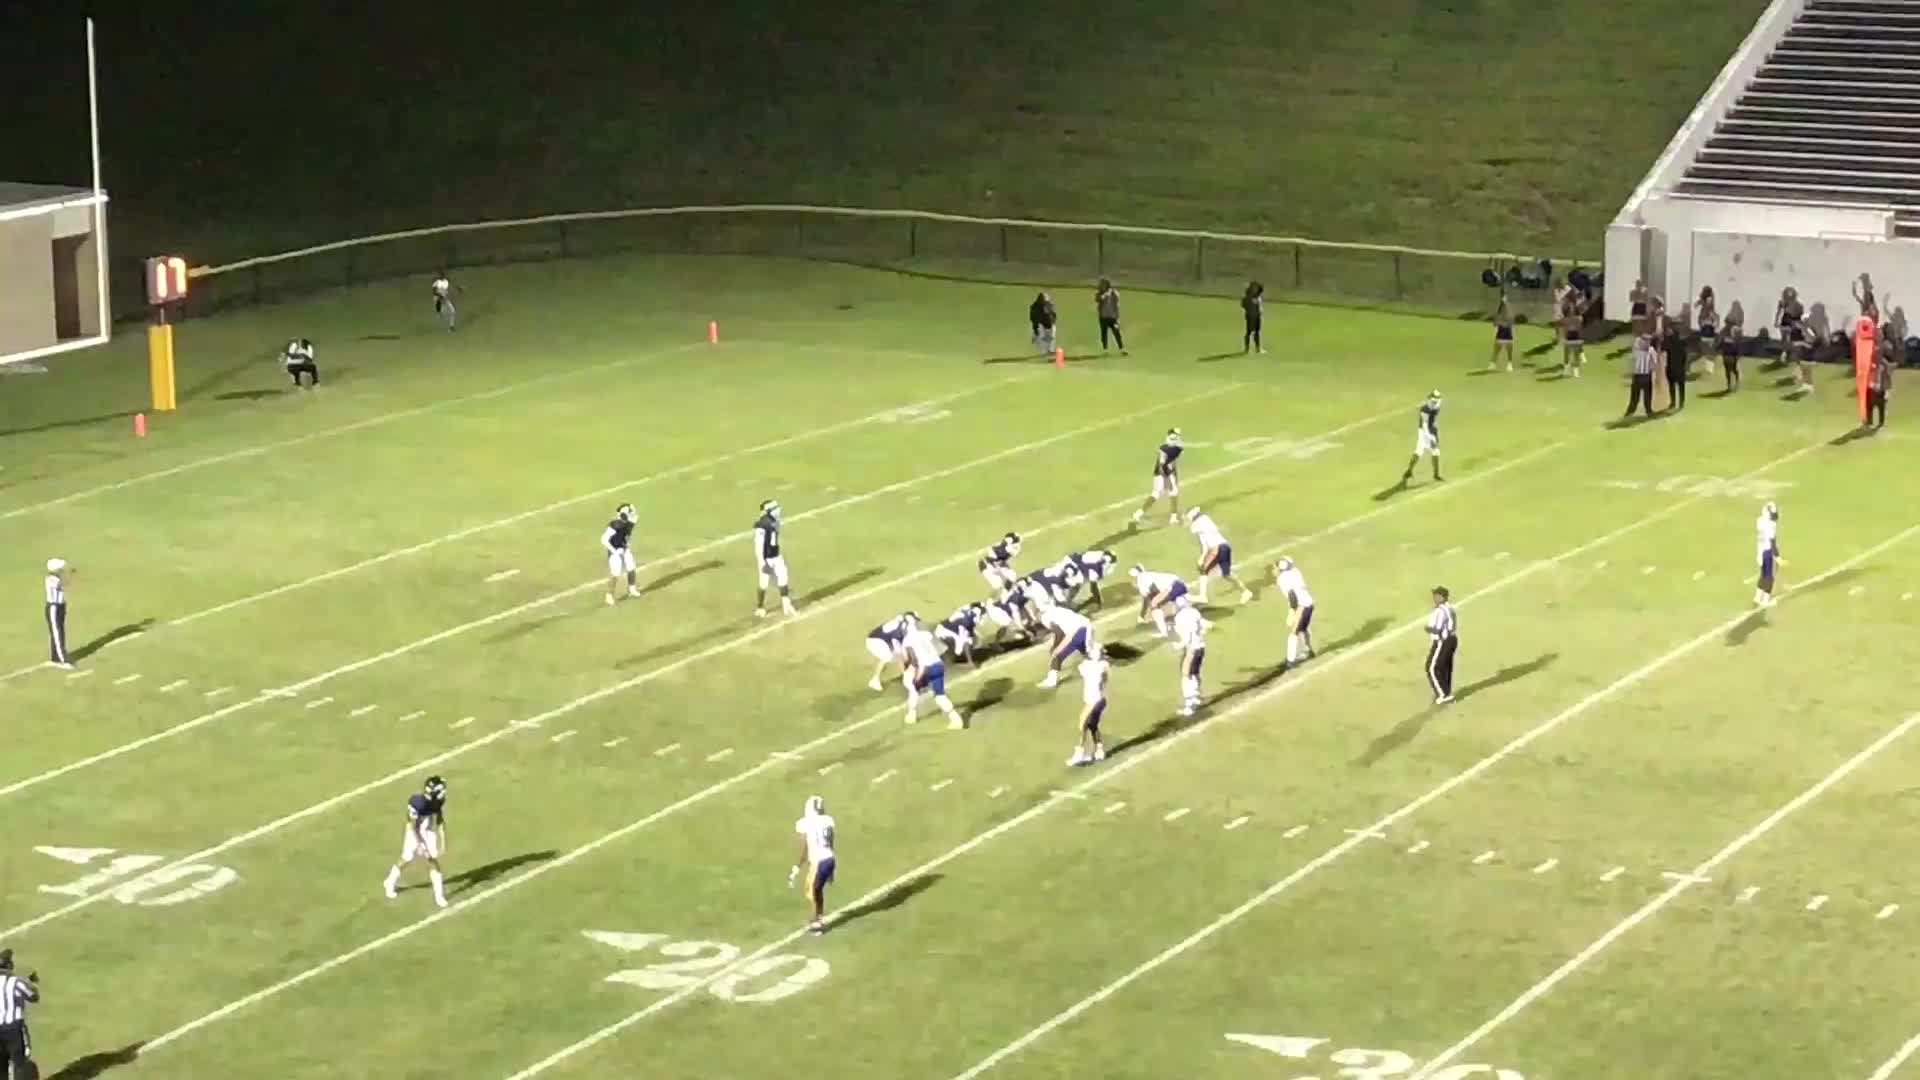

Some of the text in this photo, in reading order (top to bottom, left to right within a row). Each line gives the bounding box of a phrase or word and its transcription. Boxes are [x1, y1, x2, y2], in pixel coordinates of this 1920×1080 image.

[157, 257, 187, 298] 17
[36, 854, 240, 907] 10
[603, 940, 831, 1004] 20
